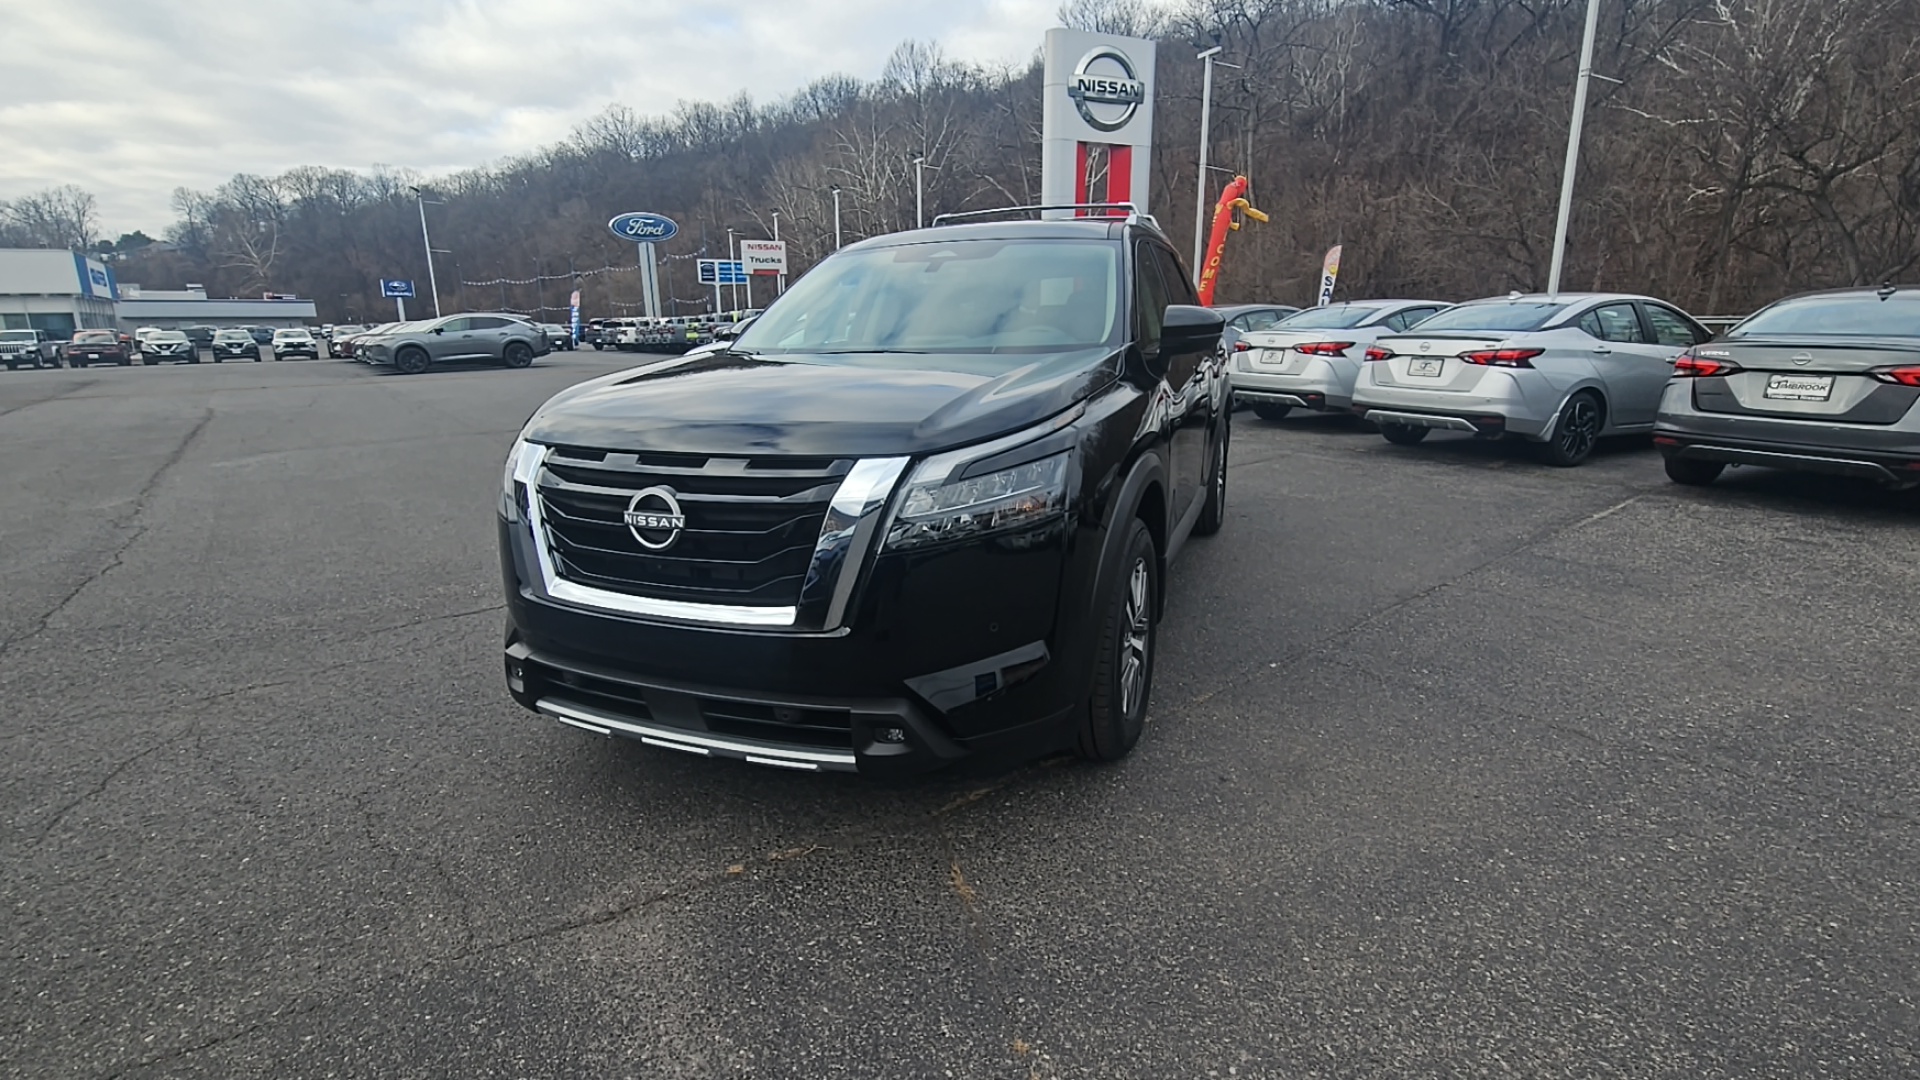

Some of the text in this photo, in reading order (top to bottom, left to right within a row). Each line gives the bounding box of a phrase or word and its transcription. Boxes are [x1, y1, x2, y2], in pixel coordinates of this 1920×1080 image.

[1078, 78, 1140, 97] NISSAN
[626, 218, 665, 235] Ford
[747, 243, 782, 251] NISSAN
[749, 256, 782, 264] Trucks
[624, 513, 683, 528] NISSAN
